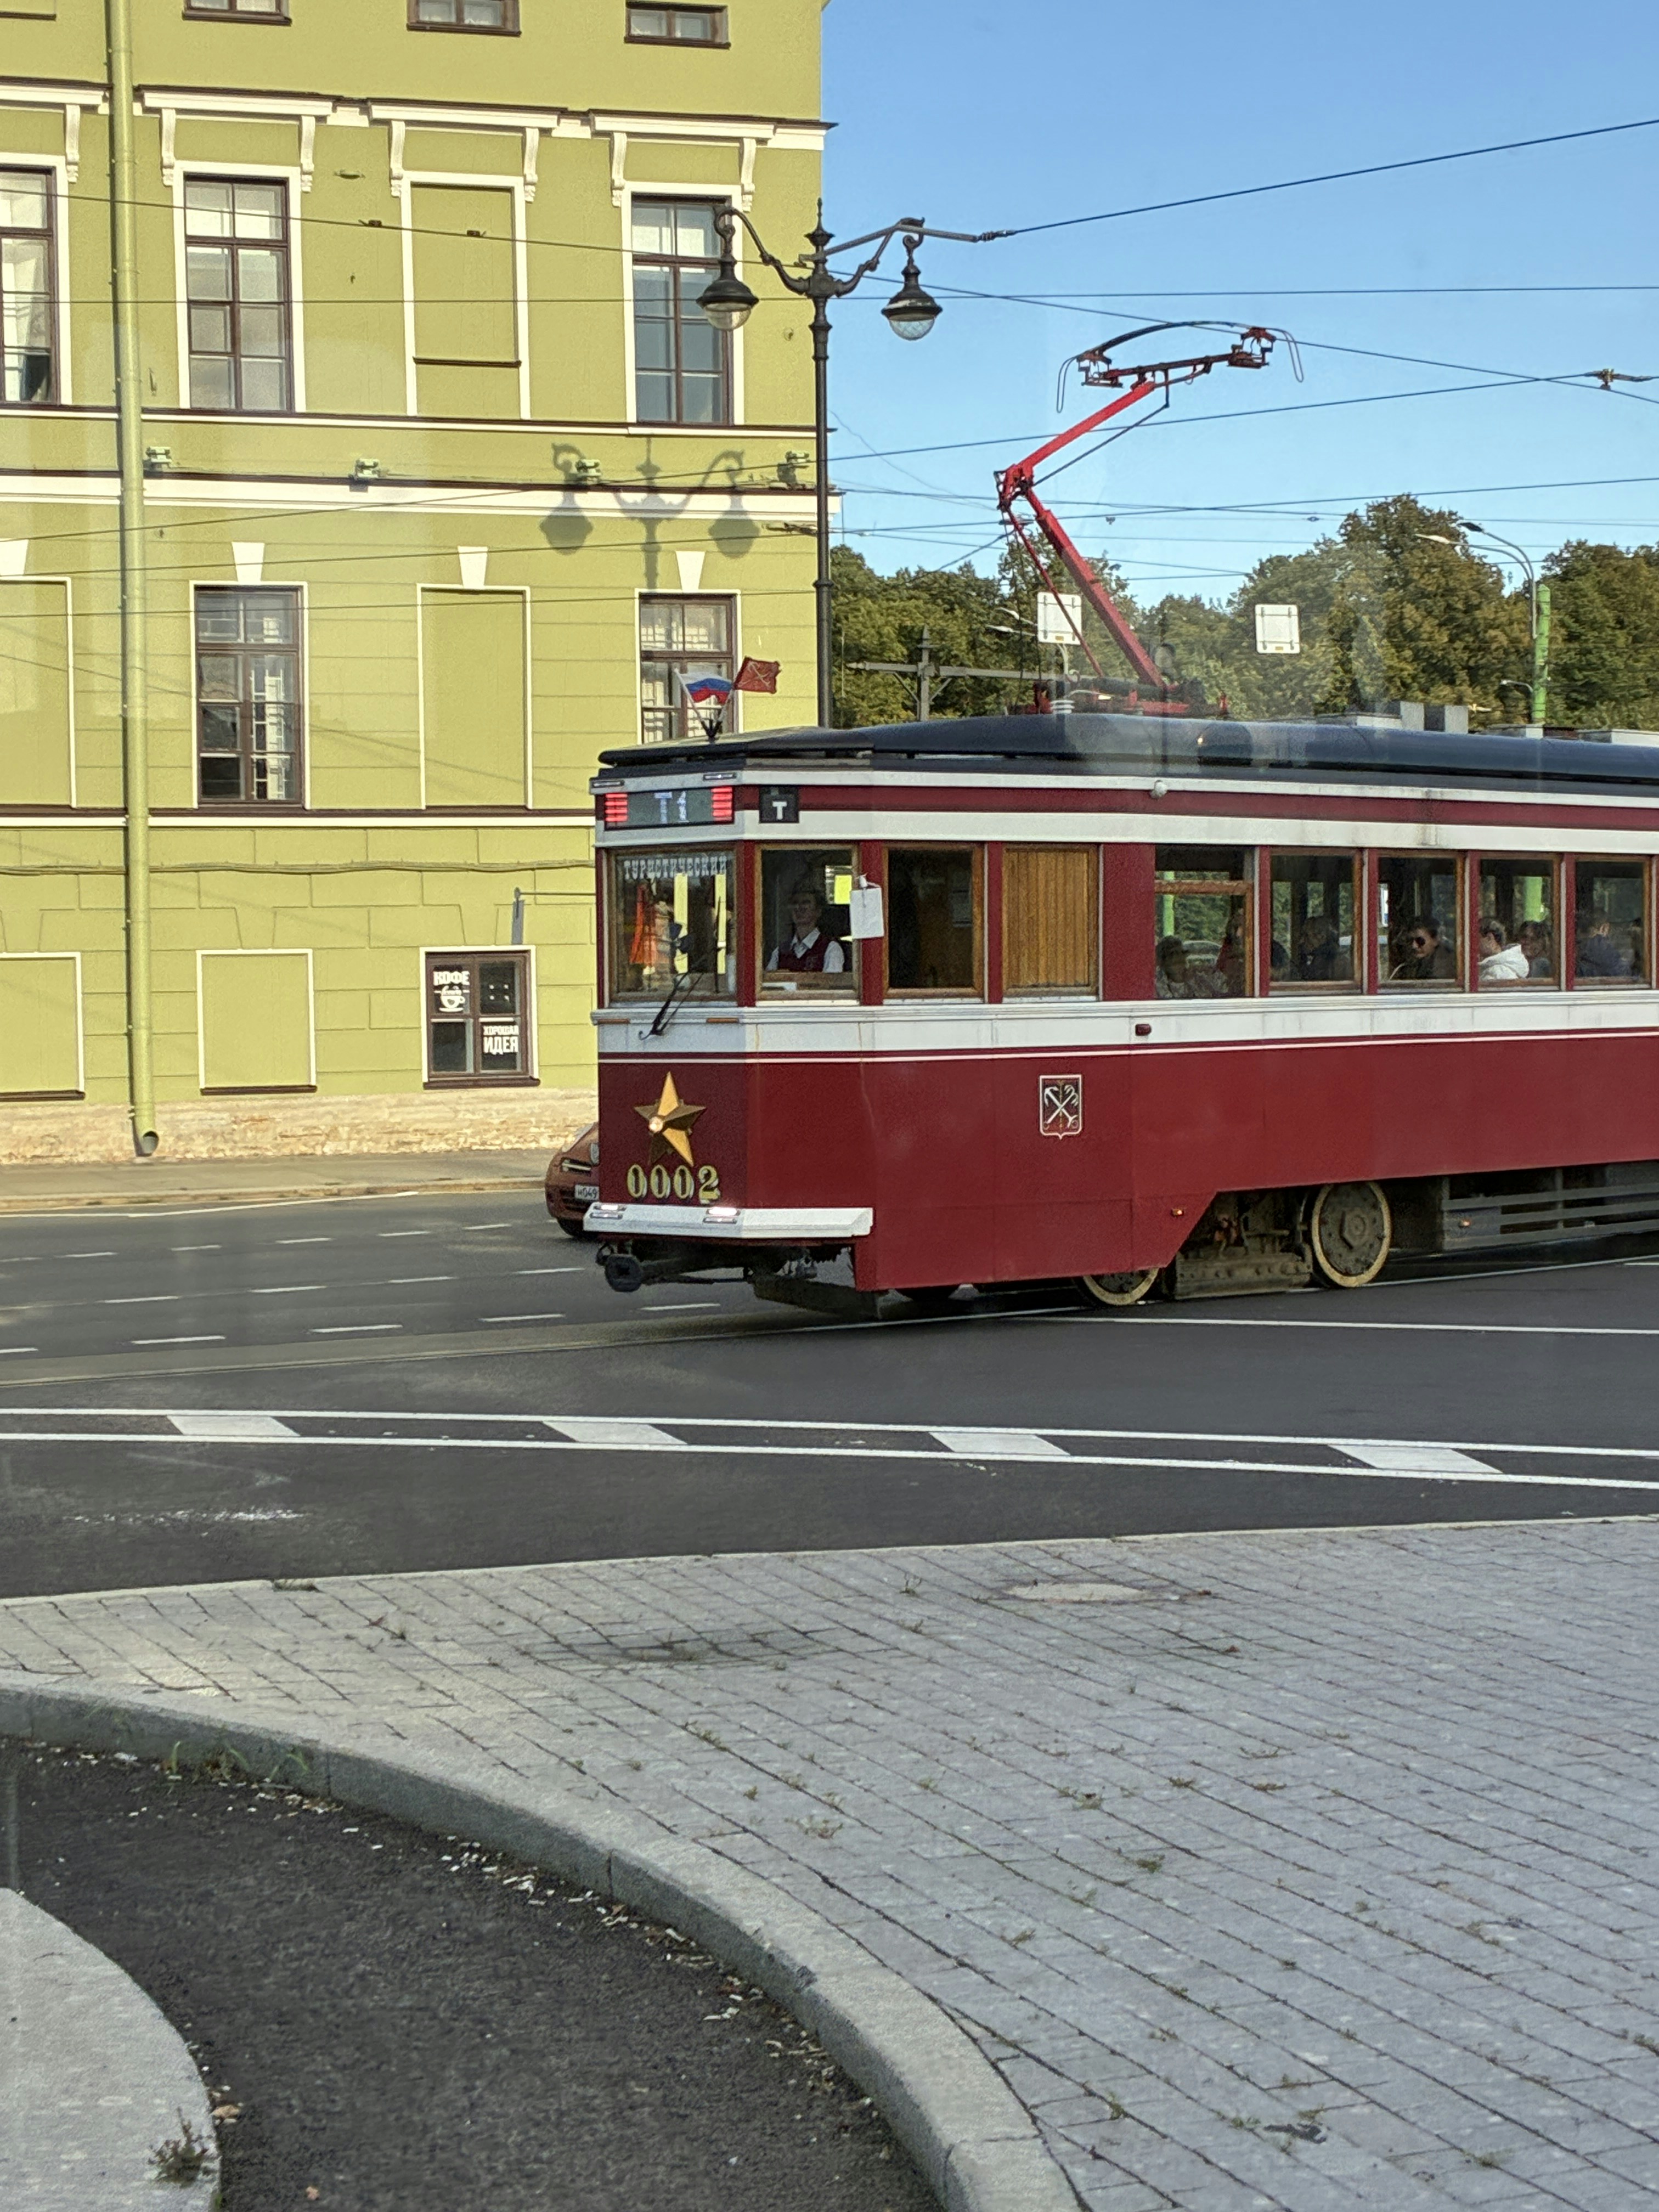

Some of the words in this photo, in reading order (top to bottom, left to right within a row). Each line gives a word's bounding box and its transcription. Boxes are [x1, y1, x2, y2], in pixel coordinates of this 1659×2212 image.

[624, 856, 727, 880] ТУРИСТИЧЕСКИЙ
[433, 970, 470, 986] КОФЕ
[483, 1036, 518, 1055] ИДЕЯ
[627, 1164, 720, 1204] 0002
